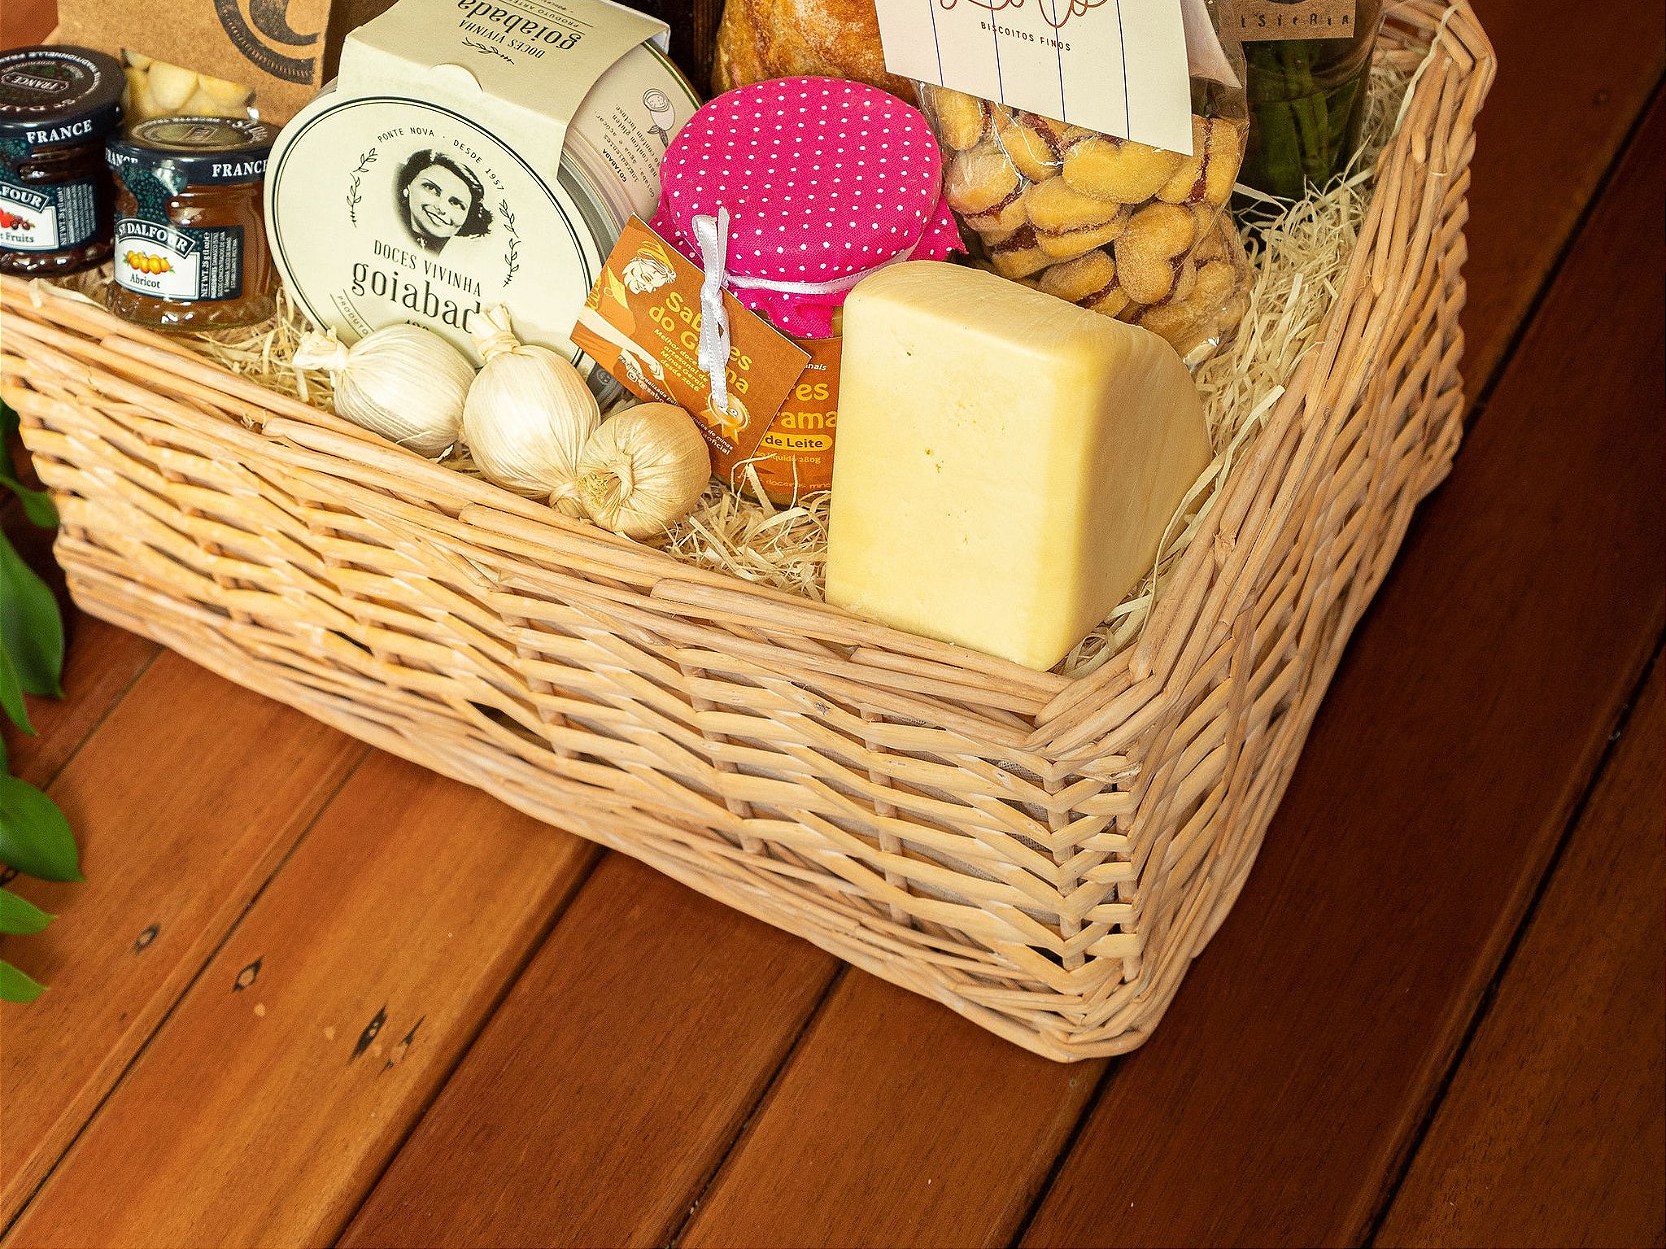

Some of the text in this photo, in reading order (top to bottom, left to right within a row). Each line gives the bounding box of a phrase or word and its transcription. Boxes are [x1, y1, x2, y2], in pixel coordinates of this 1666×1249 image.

[538, 7, 579, 28] PRODUTO
[458, 19, 546, 59] DOCES VIVINHA
[980, 21, 1071, 51] BISCOITOS FINOS
[12, 76, 59, 90] FRANCE
[26, 119, 93, 143] FRANCE
[377, 127, 505, 191] PONTE NOVA DESDE 1957
[126, 222, 188, 253] DALFOUR
[130, 273, 161, 289] Abricot
[373, 239, 482, 297] DOCES VIVINHA
[351, 262, 481, 334] goiabad
[648, 306, 675, 333] do
[654, 328, 698, 366] Melhor doce
[660, 350, 682, 371] Minas
[682, 369, 706, 389] Gerais
[660, 358, 682, 378] desde
[681, 376, 701, 392] 2016
[663, 345, 700, 376] artesanal
[698, 373, 709, 383] de
[764, 434, 824, 449] de Leite
